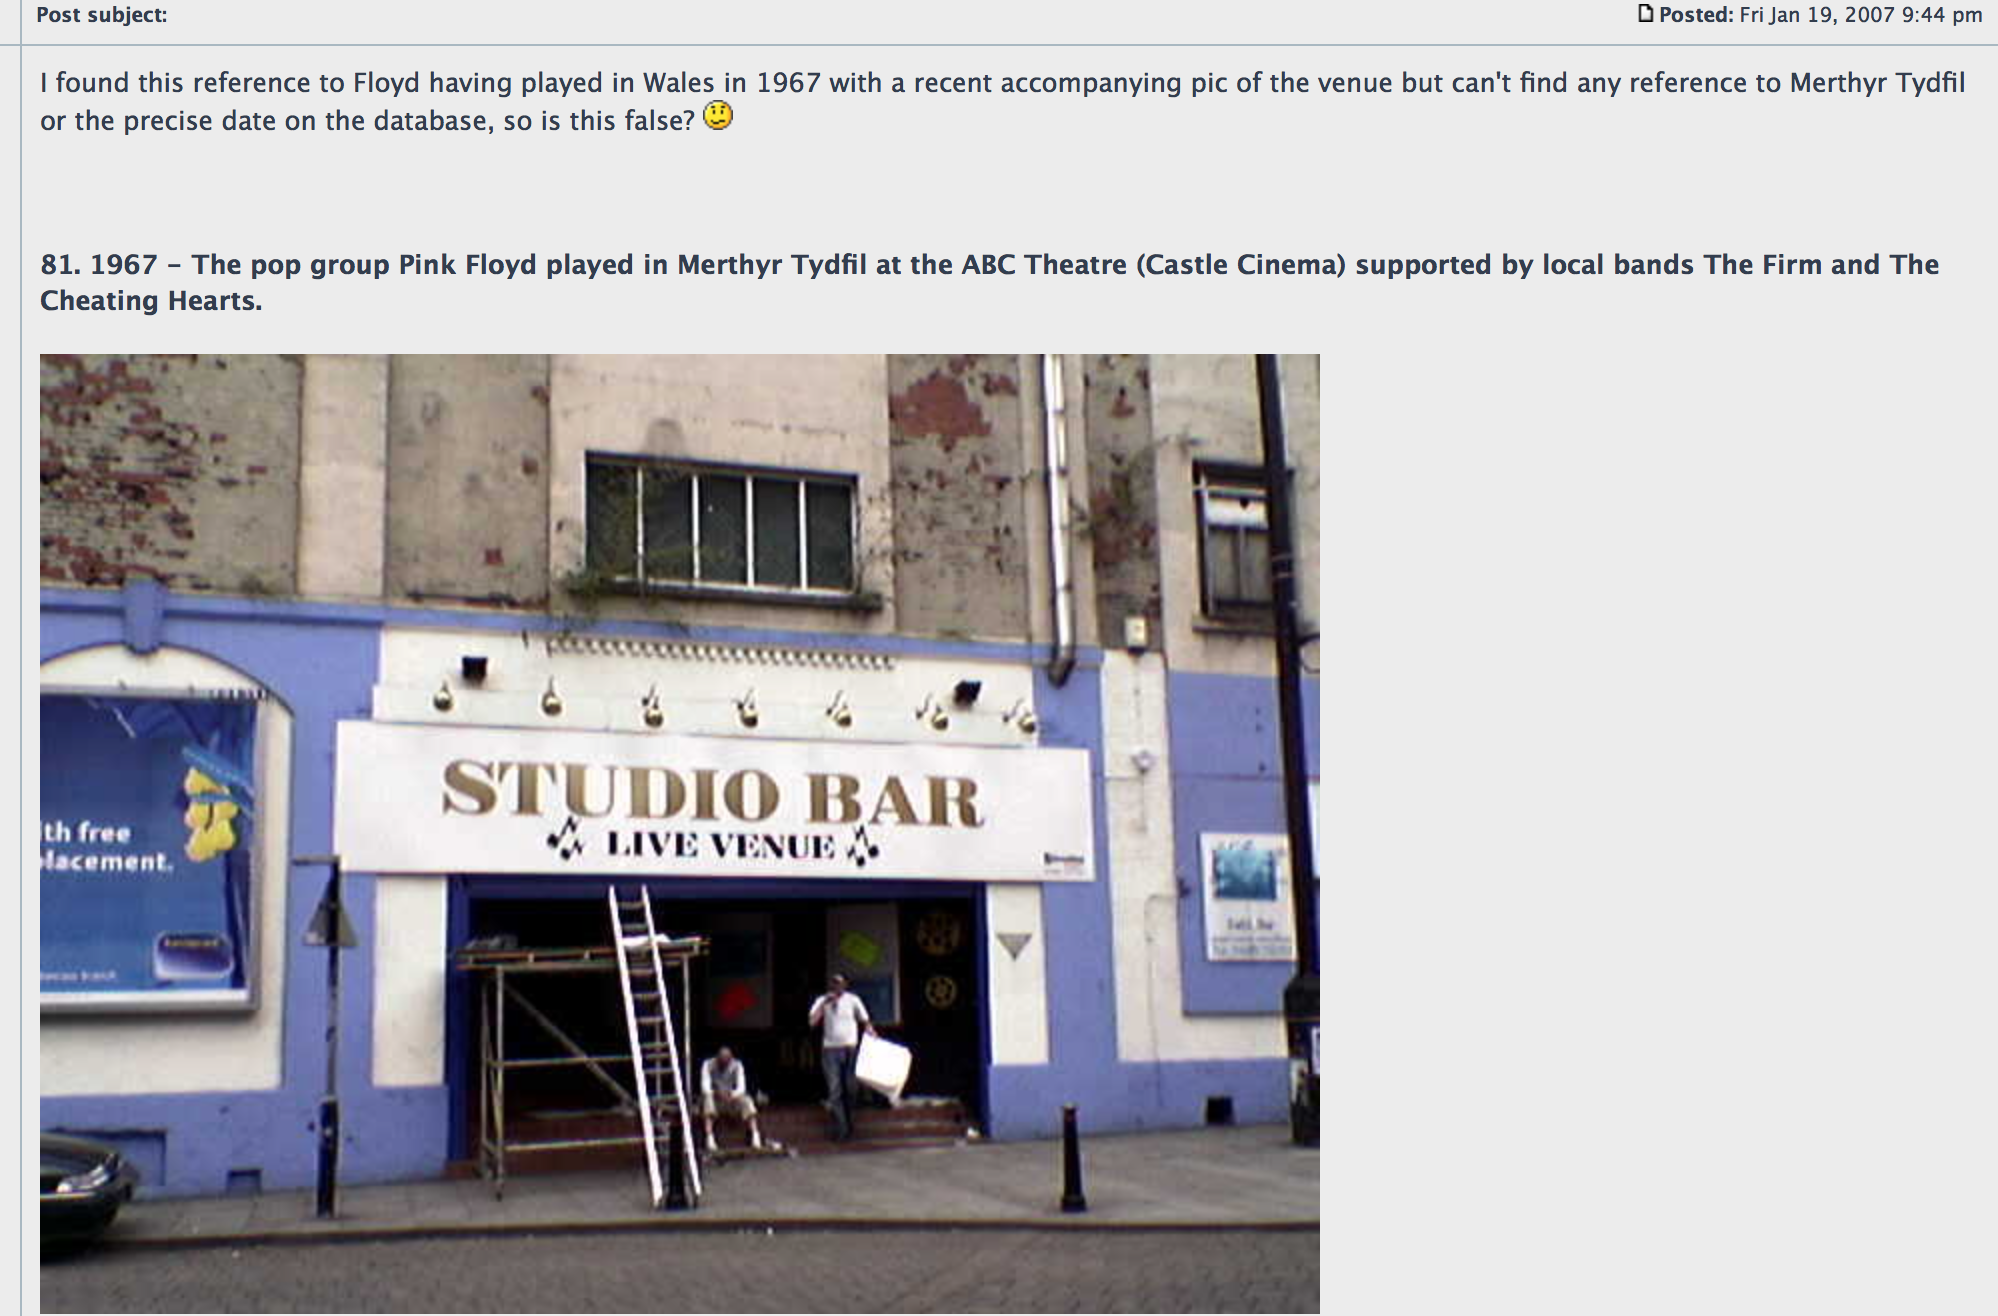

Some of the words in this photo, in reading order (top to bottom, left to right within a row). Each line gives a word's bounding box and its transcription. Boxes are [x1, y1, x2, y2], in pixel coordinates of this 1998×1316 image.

[37, 6, 81, 23] Post
[87, 5, 167, 27] subject:
[1660, 5, 1734, 23] Posted:
[1740, 6, 1764, 23] Fri
[1767, 6, 1800, 23] Jan
[1808, 5, 1838, 26] 19,
[1845, 6, 1895, 23] 2007
[1902, 5, 1946, 23] 9:44
[1953, 9, 1983, 27] pm
[41, 72, 47, 93] I
[55, 70, 129, 93] found
[138, 70, 184, 93] this
[194, 70, 311, 93] reference
[319, 74, 345, 93] to
[354, 70, 419, 98] Floyd
[430, 70, 512, 98] having
[522, 70, 602, 98] played
[613, 72, 634, 93] in
[642, 70, 715, 93] Wales
[725, 72, 746, 93] in
[758, 71, 821, 94] 1967
[828, 70, 882, 93] with
[891, 76, 906, 93] a
[915, 74, 993, 93] recent
[1001, 72, 1181, 98] accompanying
[1192, 72, 1228, 98] pic
[1236, 70, 1264, 93] of
[1269, 70, 1310, 93] the
[1317, 76, 1393, 93] venue
[1402, 70, 1444, 93] but
[1452, 70, 1512, 93] can't
[1519, 70, 1567, 93] find
[1577, 76, 1622, 98] any
[1630, 70, 1747, 93] reference
[1755, 74, 1782, 93] to
[1791, 70, 1888, 98] Merthyr
[1894, 70, 1965, 98] Tydfil
[40, 114, 67, 131] or
[74, 108, 115, 131] the
[124, 110, 213, 136] precise
[222, 108, 276, 131] date
[285, 114, 316, 131] on
[325, 108, 365, 131] the
[374, 108, 494, 135] database,
[504, 114, 533, 131] so
[542, 110, 561, 131] is
[569, 108, 616, 131] this
[624, 108, 696, 131] false?
[41, 253, 81, 276] 81.
[91, 253, 158, 276] 1967
[190, 252, 242, 275] The
[251, 258, 302, 280] pop
[310, 258, 390, 280] group
[400, 252, 457, 275] Pink
[466, 252, 536, 280] Floyd
[547, 252, 633, 280] played
[644, 253, 668, 275] in
[678, 252, 783, 280] Merthyr
[790, 252, 867, 280] Tydfil
[876, 256, 902, 275] at
[910, 252, 953, 275] the
[961, 253, 1016, 276] ABC
[1023, 252, 1127, 275] Theatre
[1136, 252, 1228, 279] (Castle
[1237, 252, 1346, 279] Cinema)
[1356, 252, 1491, 280] supported
[1502, 252, 1535, 280] by
[1543, 252, 1604, 275] local
[1614, 252, 1694, 275] bands
[1702, 252, 1754, 275] The
[1763, 253, 1822, 275] Firm
[1831, 252, 1880, 275] and
[1888, 252, 1940, 275] The
[40, 288, 158, 316] Cheating
[169, 290, 262, 311] Hearts.
[442, 759, 780, 823] STUDIO
[805, 773, 985, 829] BAR
[78, 820, 132, 844] free
[608, 830, 698, 858] LIVE
[711, 833, 836, 860] VENUE
